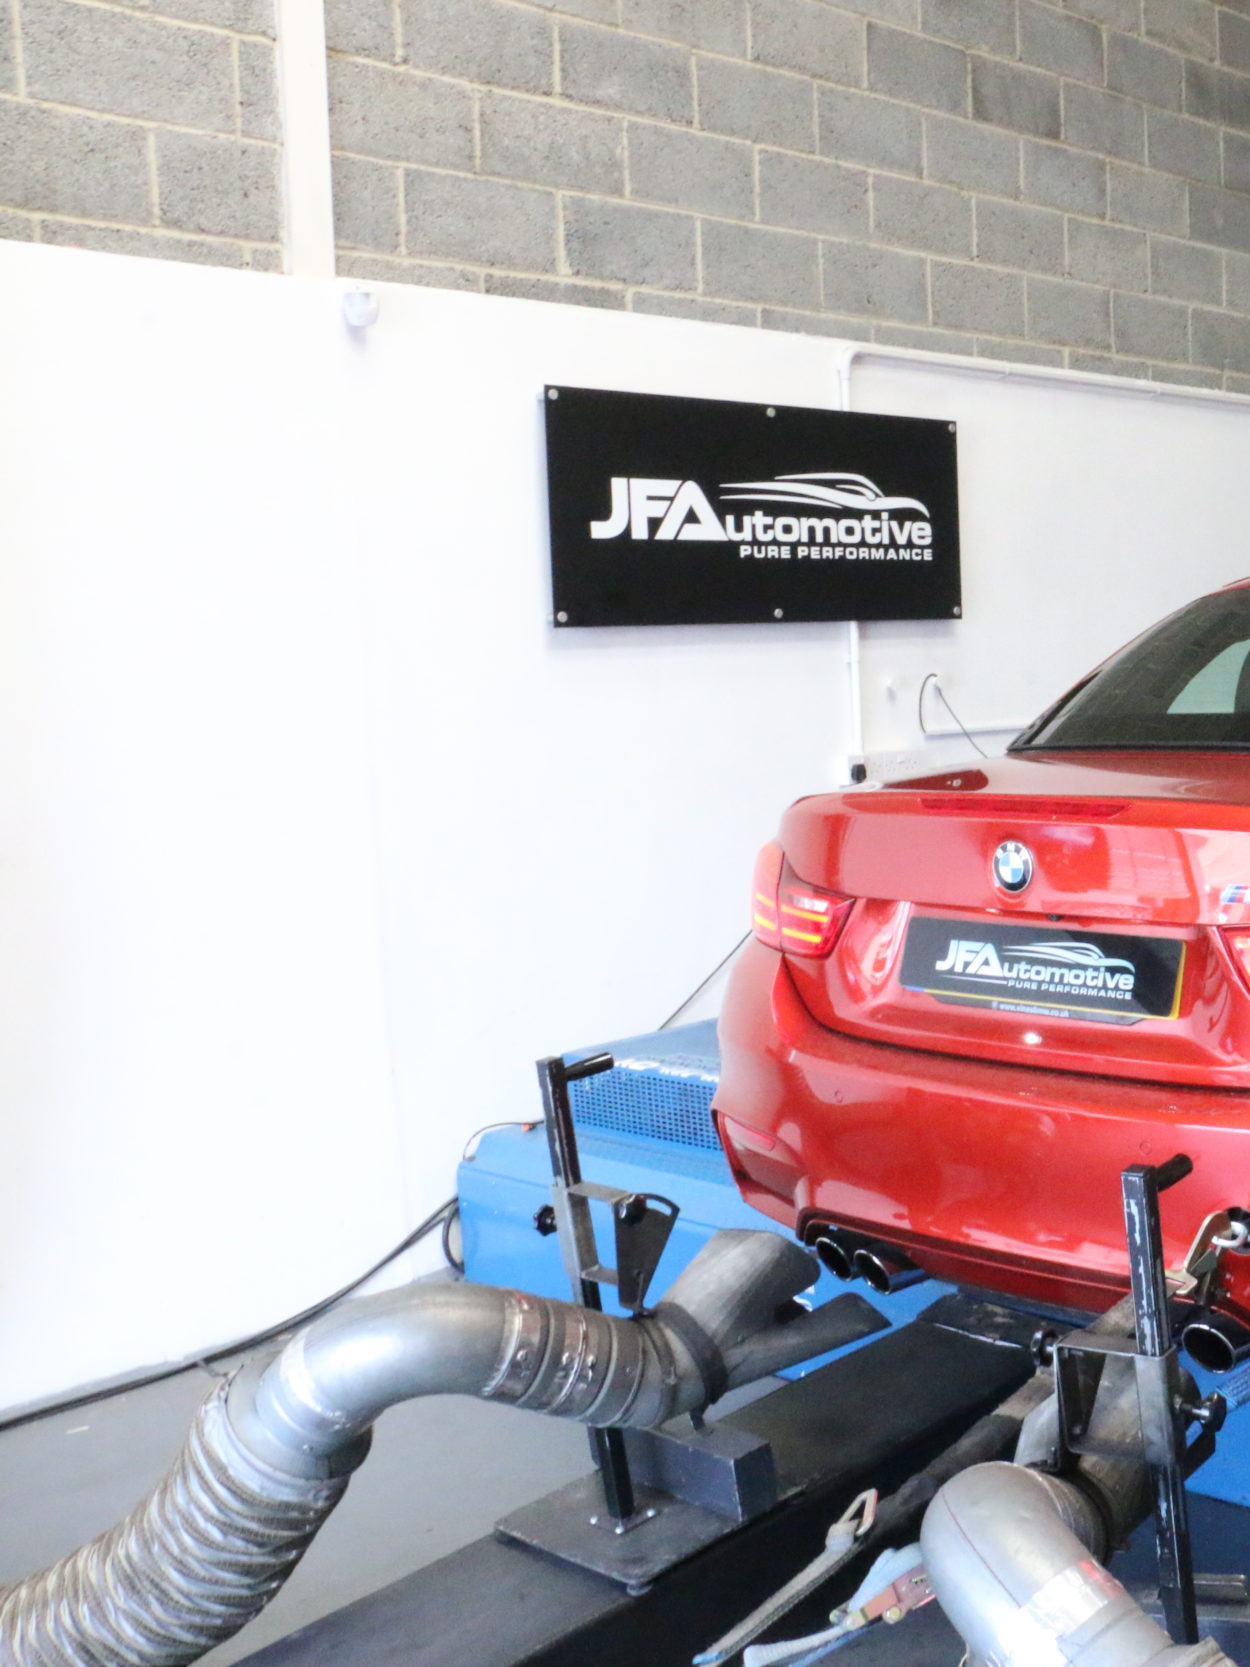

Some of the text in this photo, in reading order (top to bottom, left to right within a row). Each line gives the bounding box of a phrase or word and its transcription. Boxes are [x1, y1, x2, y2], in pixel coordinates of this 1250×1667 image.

[739, 544, 933, 561] PURE PERFORMANCE
[1007, 979, 1132, 1001] PURE PERFORMANCE
